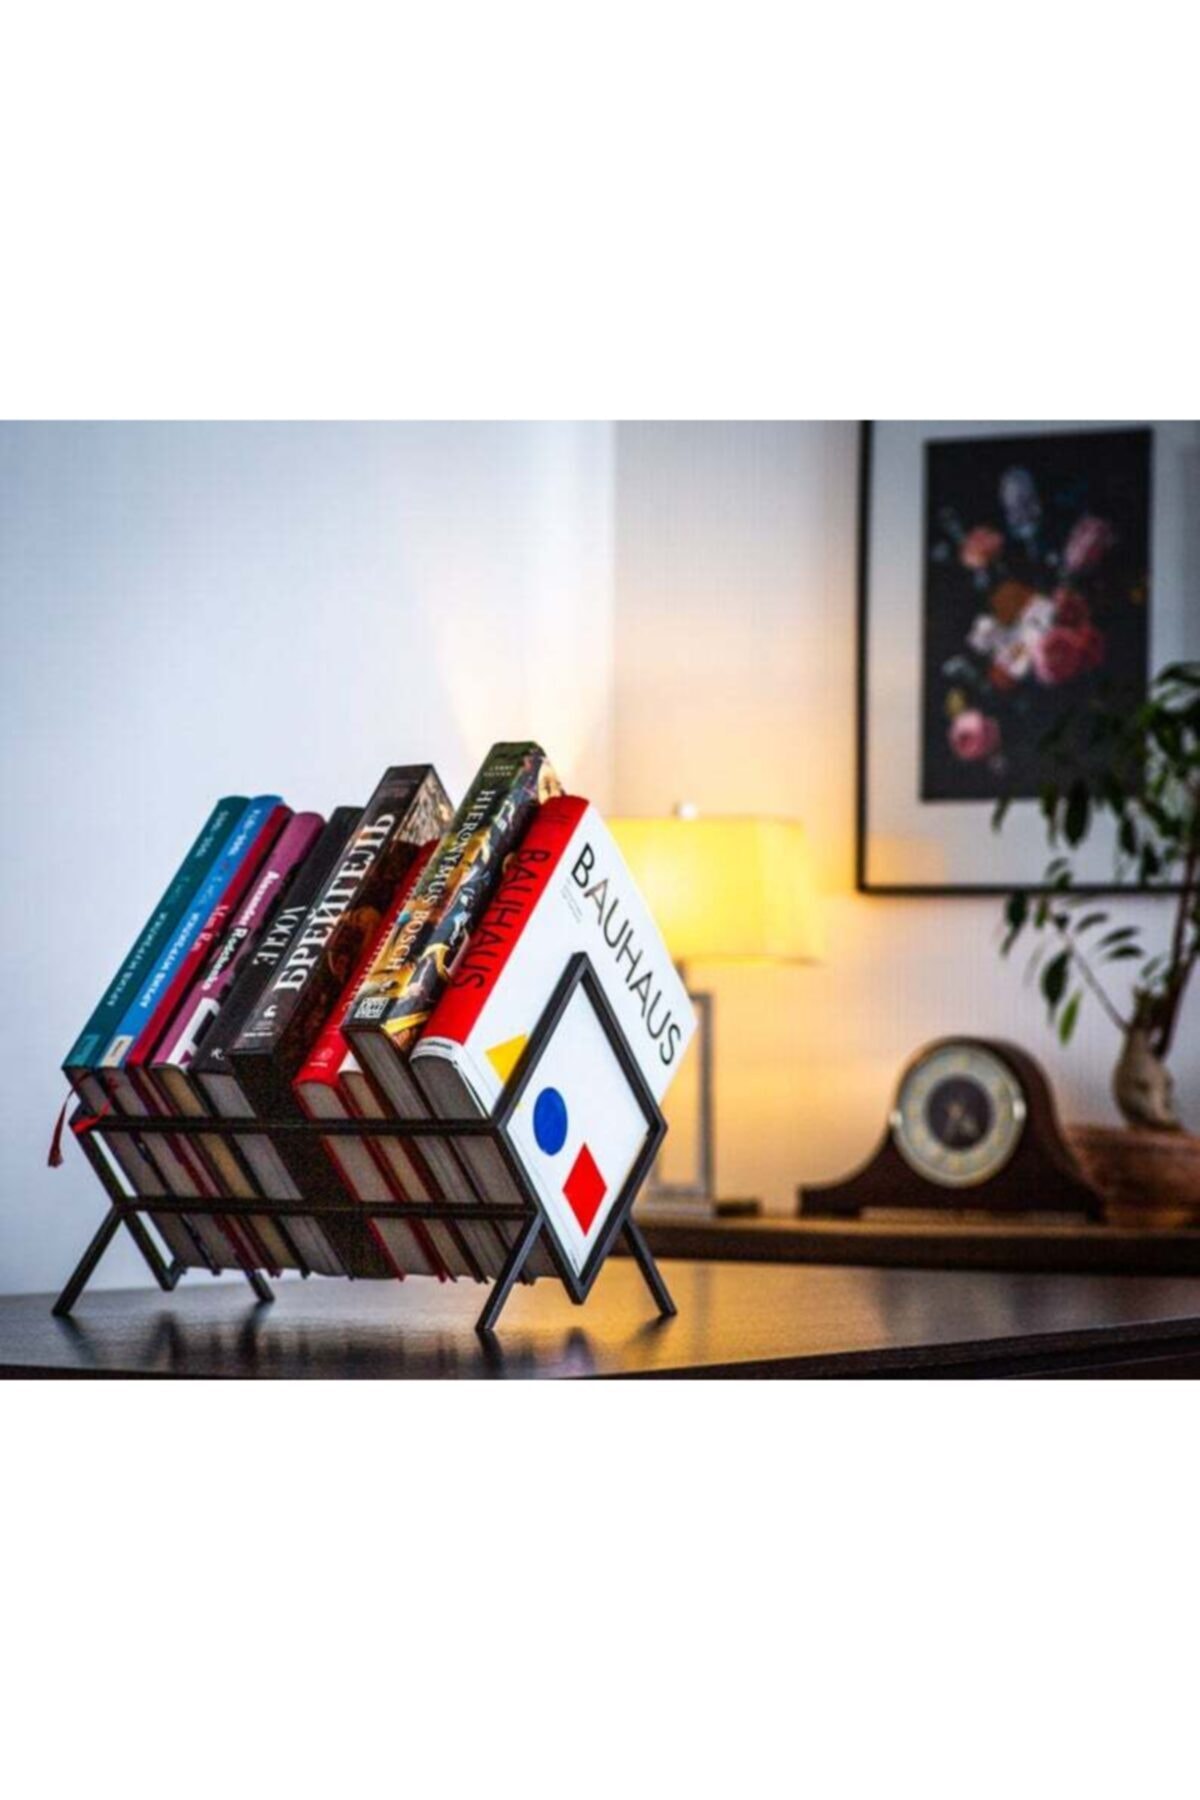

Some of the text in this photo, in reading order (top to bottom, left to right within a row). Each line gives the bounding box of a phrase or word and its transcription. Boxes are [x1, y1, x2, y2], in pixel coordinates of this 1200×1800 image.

[238, 870, 280, 926] Alexander
[252, 904, 307, 965] VOGUE
[273, 813, 396, 991] БРЕЙГЕЛЬ
[385, 789, 497, 972] HIERONYMUS BOSCH
[451, 848, 551, 989] BAUHAUS
[201, 927, 249, 991] Rodchenko
[571, 842, 681, 1066] BAUHAUS
